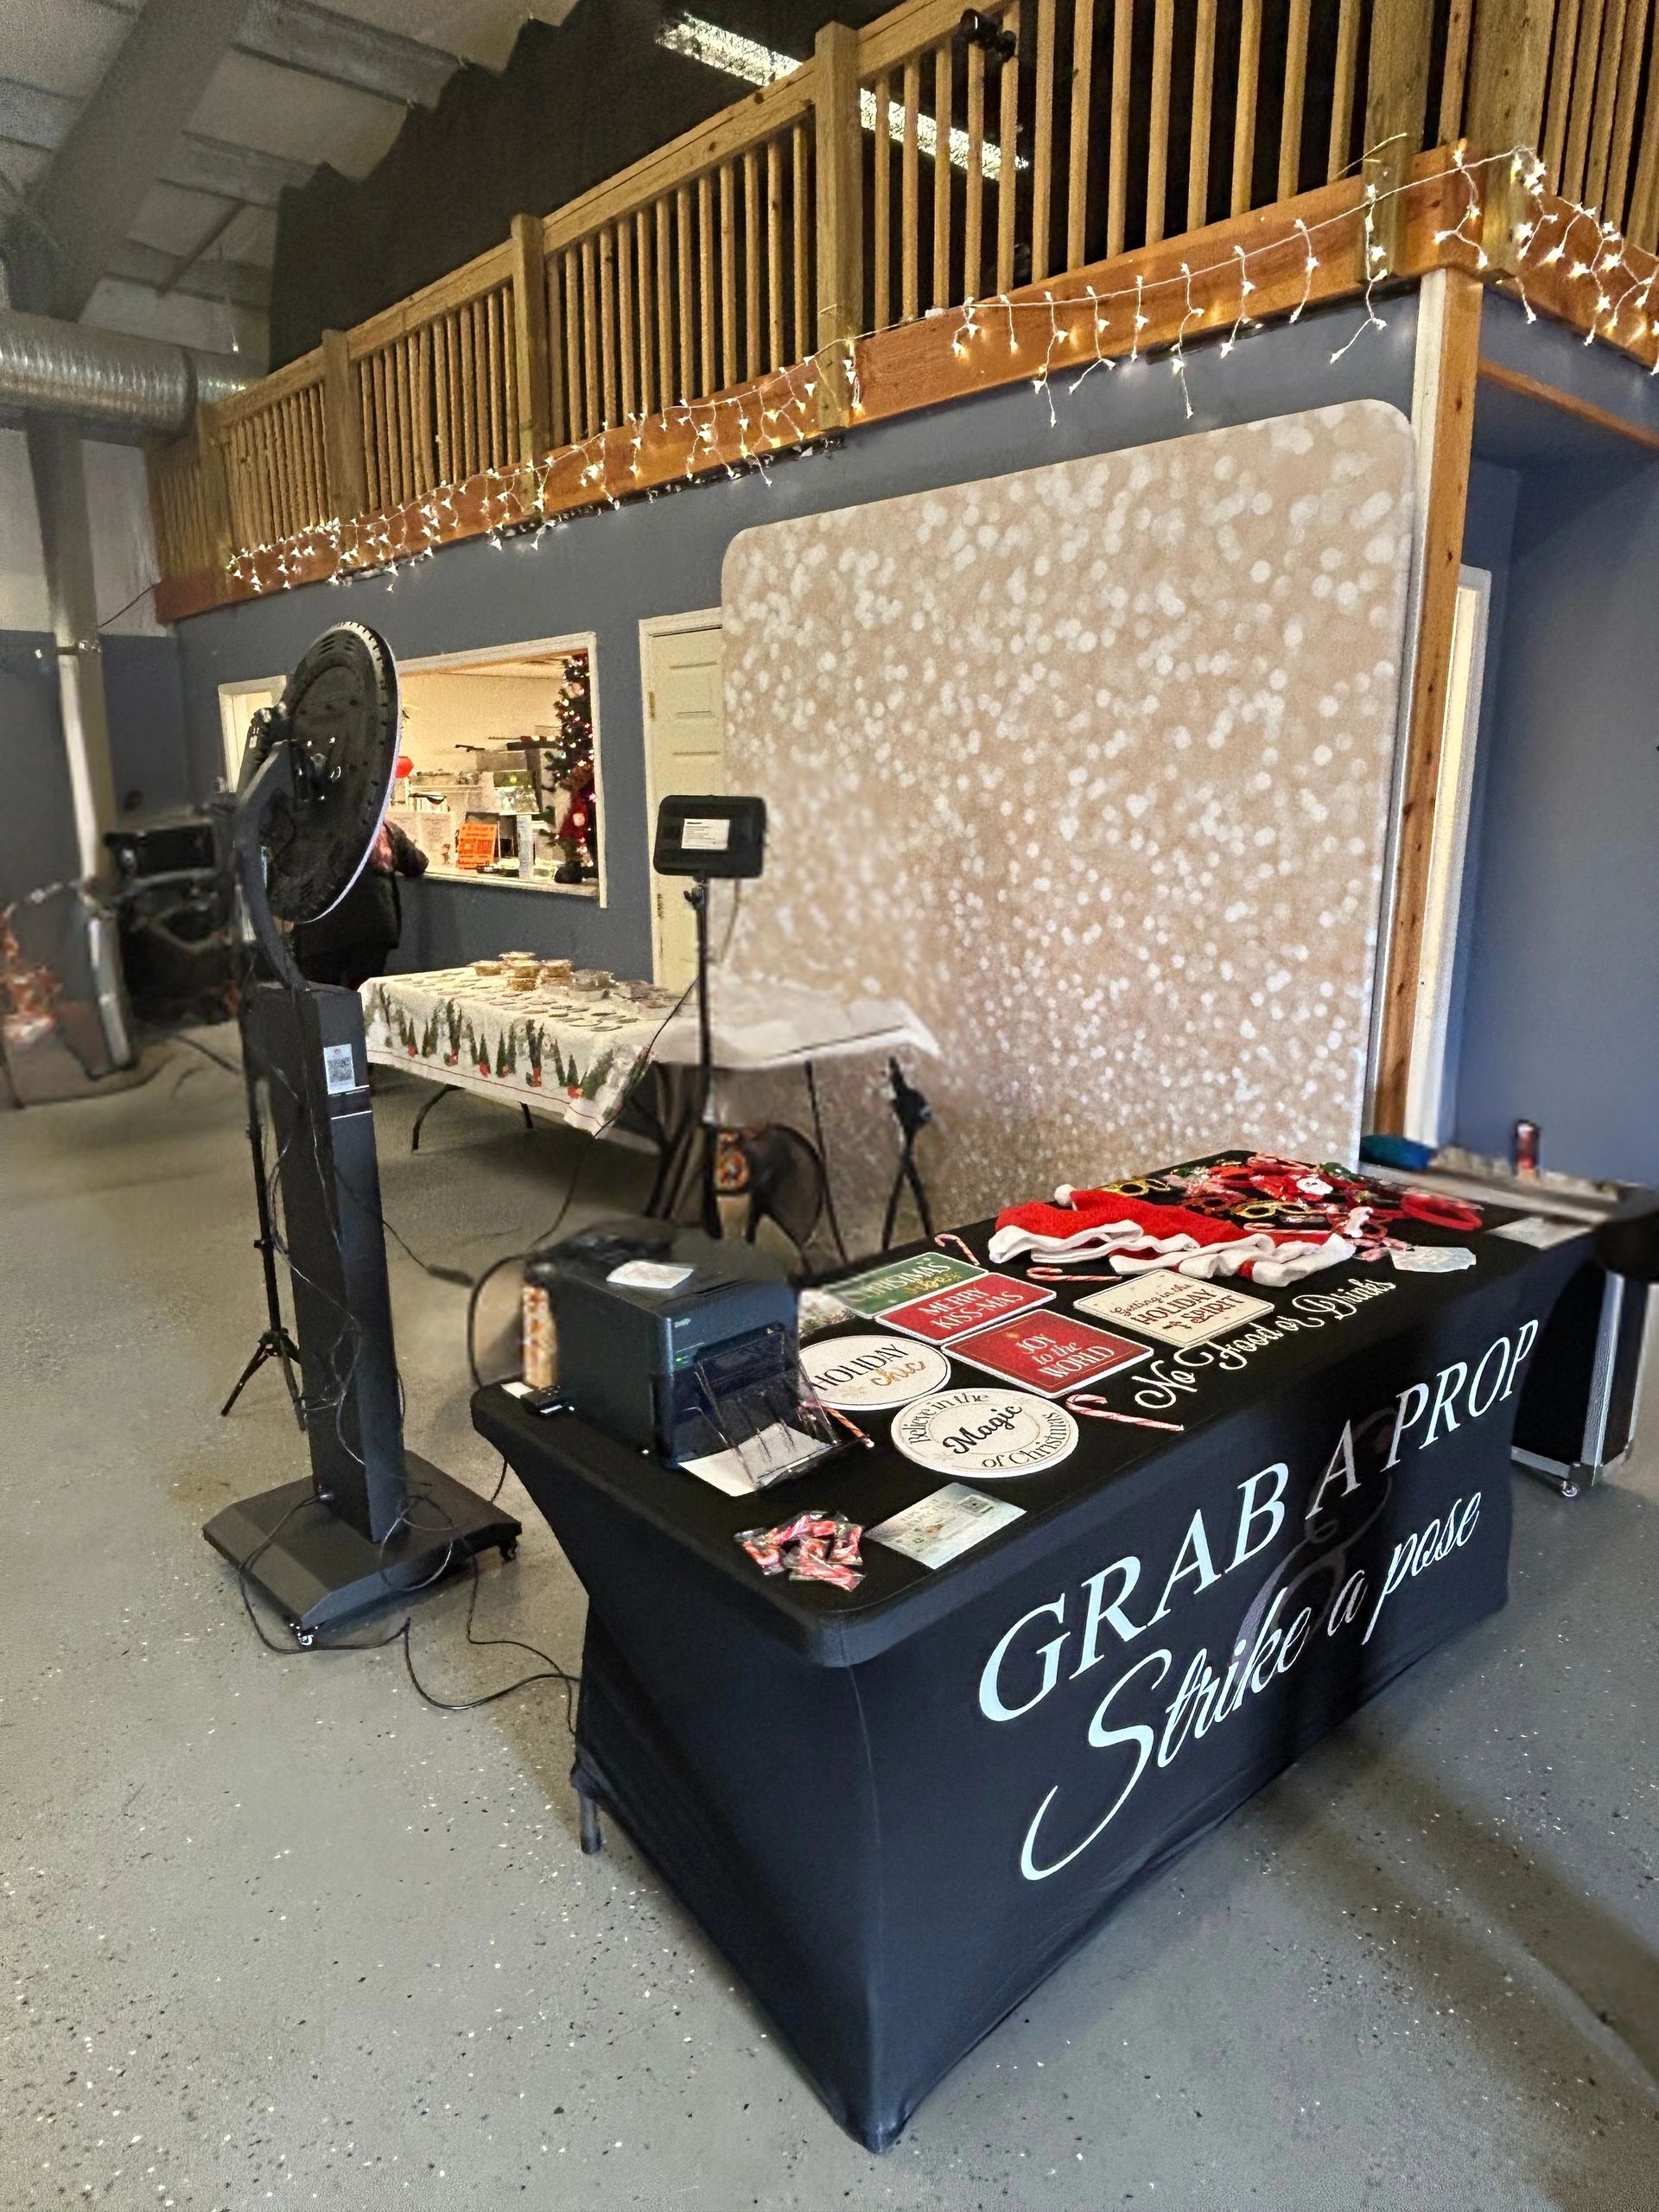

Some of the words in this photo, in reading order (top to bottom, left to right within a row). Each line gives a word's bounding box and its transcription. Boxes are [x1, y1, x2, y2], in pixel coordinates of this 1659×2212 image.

[918, 1287, 989, 1316] MERRY
[931, 1291, 1024, 1330] KISS-MAS
[1131, 1288, 1217, 1325] HOLIDAY
[1181, 1294, 1245, 1325] SPIRIT
[1292, 1278, 1397, 1321] Drinks
[1015, 1333, 1056, 1355] JOY
[1274, 1315, 1325, 1332] or
[1032, 1353, 1053, 1365] to
[1051, 1342, 1082, 1357] the
[1038, 1345, 1115, 1378] WORLD
[1173, 1322, 1284, 1370] Food
[812, 1344, 910, 1391] HOLIDAY
[871, 1361, 926, 1387] chic
[1134, 1359, 1198, 1409] No
[902, 1408, 937, 1445] Believe
[926, 1398, 949, 1410] in
[953, 1392, 989, 1404] the
[943, 1404, 1023, 1454] Magic
[982, 1454, 1006, 1468] of
[1008, 1411, 1068, 1465] Christmas
[978, 1462, 1290, 1721] GRAB
[1305, 1419, 1363, 1521] A
[1380, 1319, 1541, 1473] PROP
[1020, 1586, 1313, 1881] Strike
[1328, 1569, 1370, 1637] a
[1362, 1491, 1483, 1645] pose
